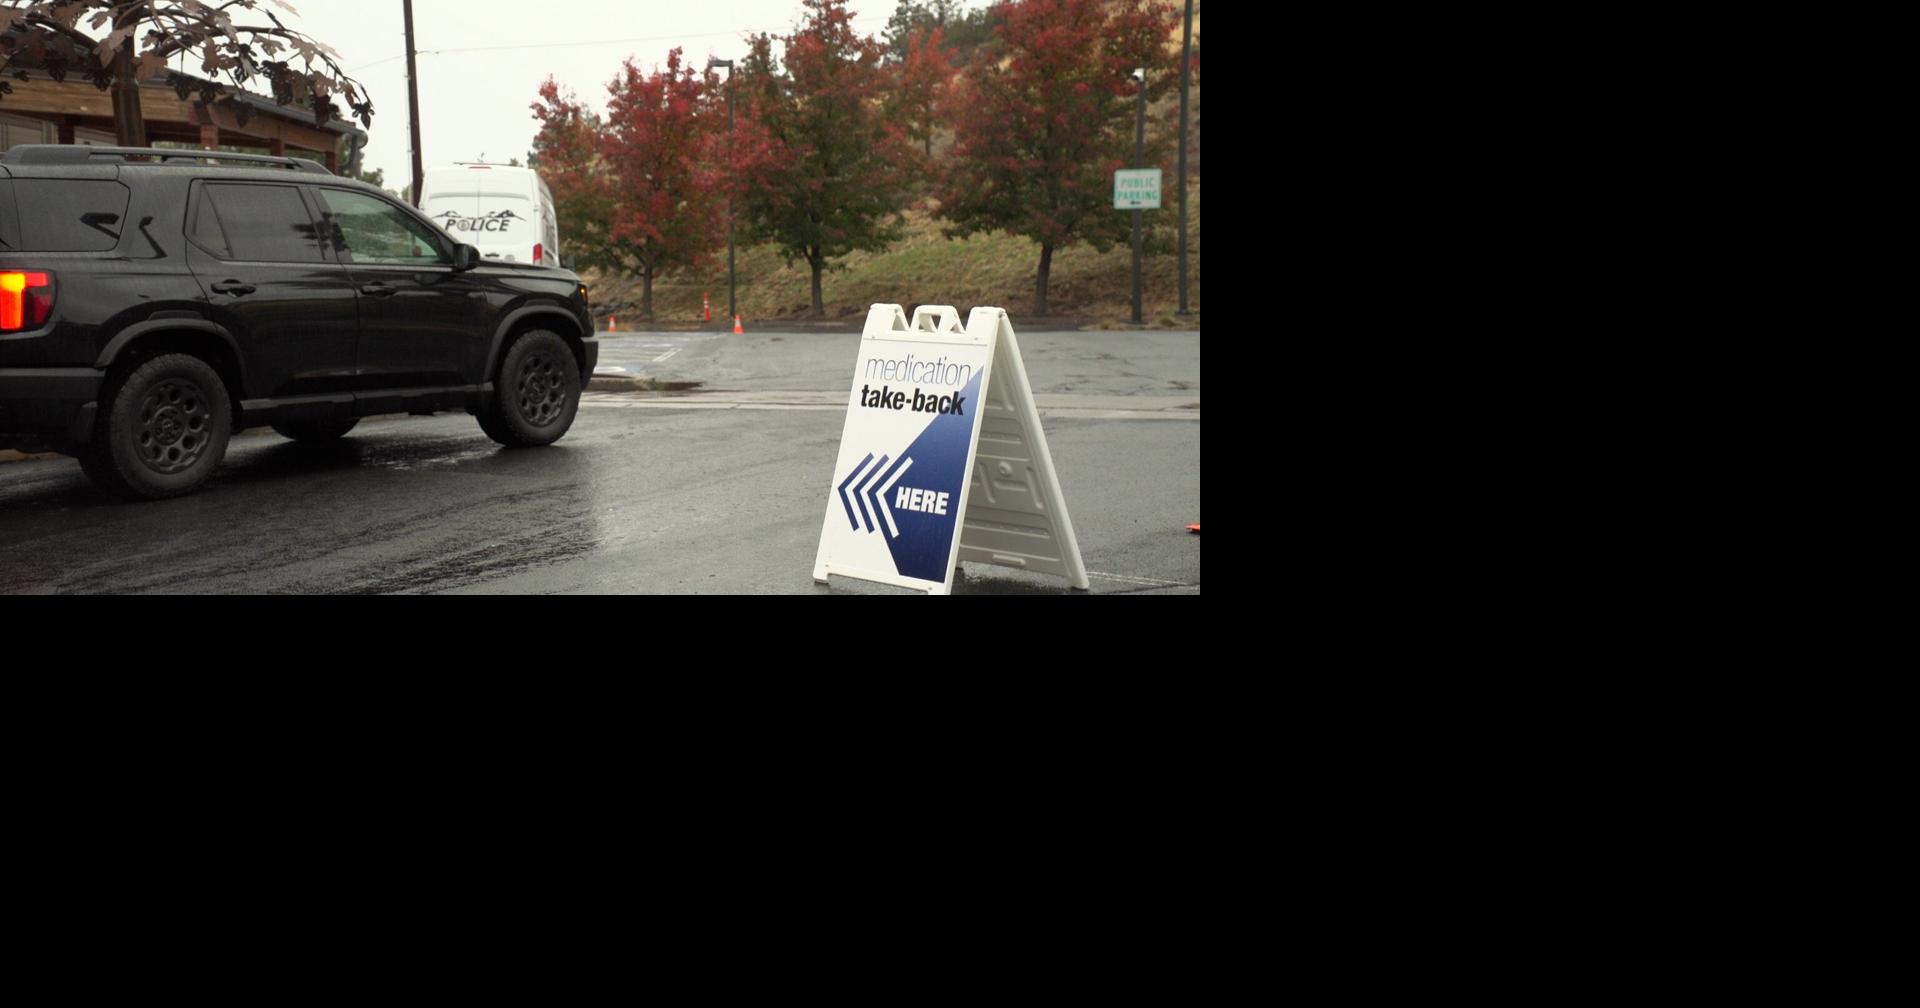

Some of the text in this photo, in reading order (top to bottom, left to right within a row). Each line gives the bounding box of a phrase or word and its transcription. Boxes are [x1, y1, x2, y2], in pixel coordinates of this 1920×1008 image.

[1120, 176, 1155, 189] PUBLIC
[1116, 190, 1159, 201] PARKING
[444, 218, 511, 232] POLICE
[865, 353, 971, 387] medication
[860, 384, 966, 416] take-back
[895, 486, 949, 515] HERE
